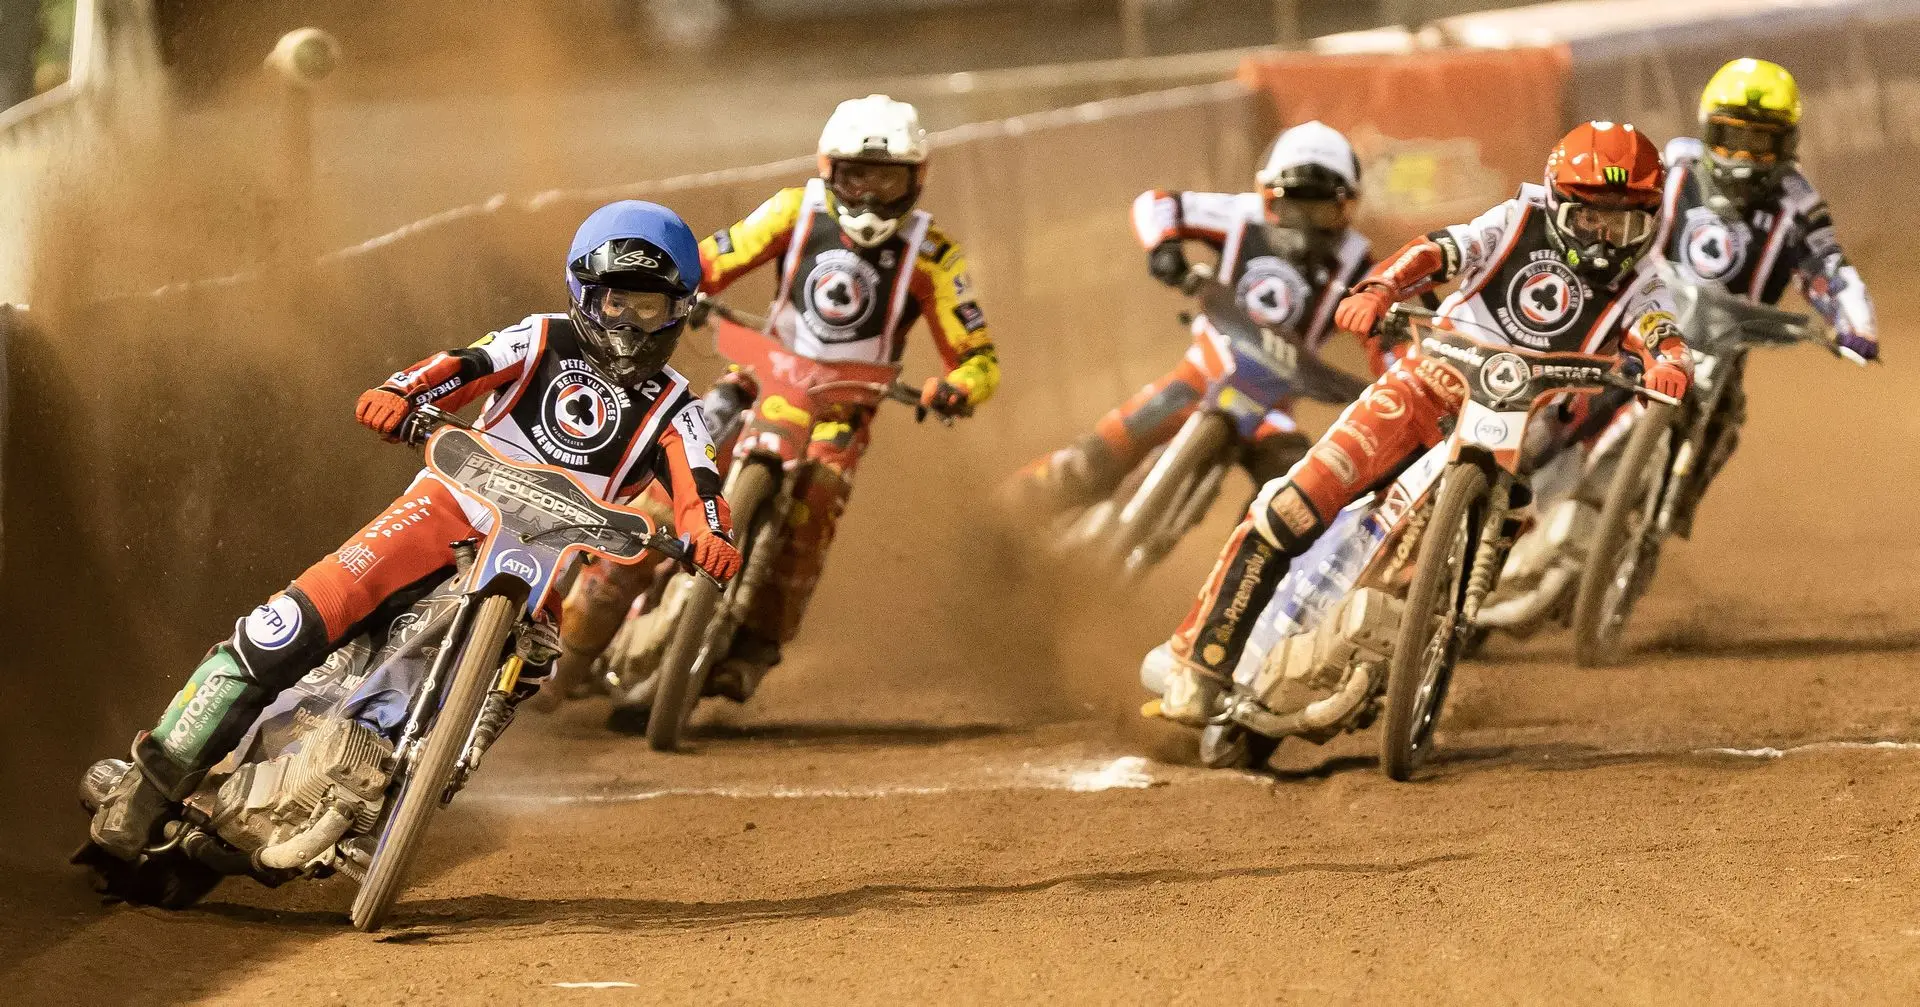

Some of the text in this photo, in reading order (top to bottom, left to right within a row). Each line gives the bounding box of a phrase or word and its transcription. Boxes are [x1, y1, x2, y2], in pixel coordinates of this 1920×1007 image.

[556, 374, 616, 421] BELLE VUE ACES
[530, 424, 590, 466] MEMORIAL
[552, 425, 584, 447] MANCHESTER
[382, 507, 431, 538] POINT
[494, 476, 601, 529] POLCOPPER
[502, 558, 534, 579] ATPI
[194, 679, 236, 732] Switzerlan
